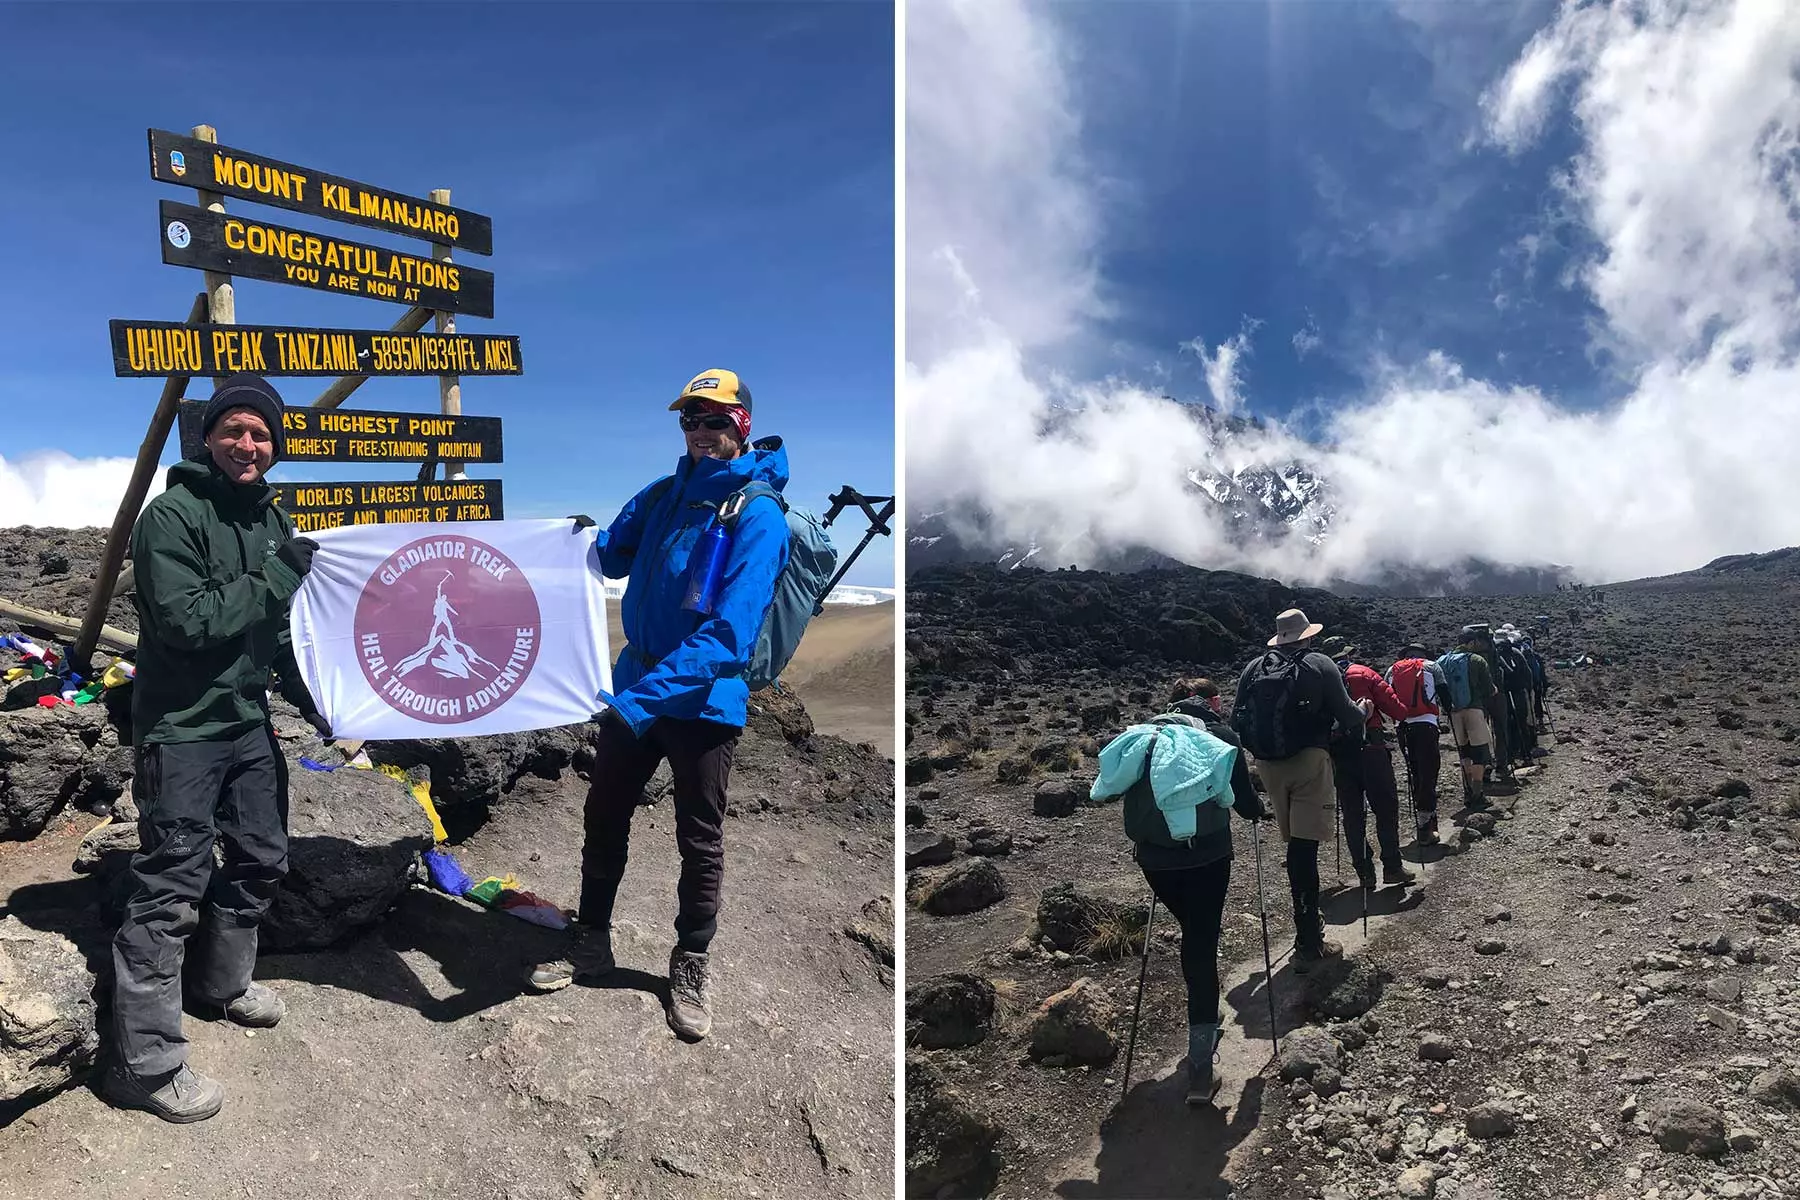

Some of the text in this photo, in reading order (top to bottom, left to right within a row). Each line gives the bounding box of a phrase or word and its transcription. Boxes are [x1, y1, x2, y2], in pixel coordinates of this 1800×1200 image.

[213, 154, 459, 239] MOUNT KILIMANJARO
[225, 220, 460, 292] CONGRATULATIONS
[285, 263, 420, 301] YOU ARE NOW AT
[127, 327, 202, 371] UHURU
[213, 331, 267, 371] PEAK
[484, 339, 517, 371] AMSL
[320, 415, 399, 434] HIGHEST
[409, 419, 456, 436] POINT
[286, 438, 337, 455] HIGHEST
[438, 442, 482, 458] MOUNTAIN
[296, 487, 353, 506] WORLD'S
[361, 486, 417, 504] LARGEST
[423, 484, 485, 502] VOLCANOES
[354, 510, 378, 524] AND
[436, 505, 449, 522] OF
[456, 504, 491, 521] AFRICA
[380, 541, 511, 586] GLADIATOR TREK
[361, 627, 534, 716] HEAL THROUGH ADVENTURE
